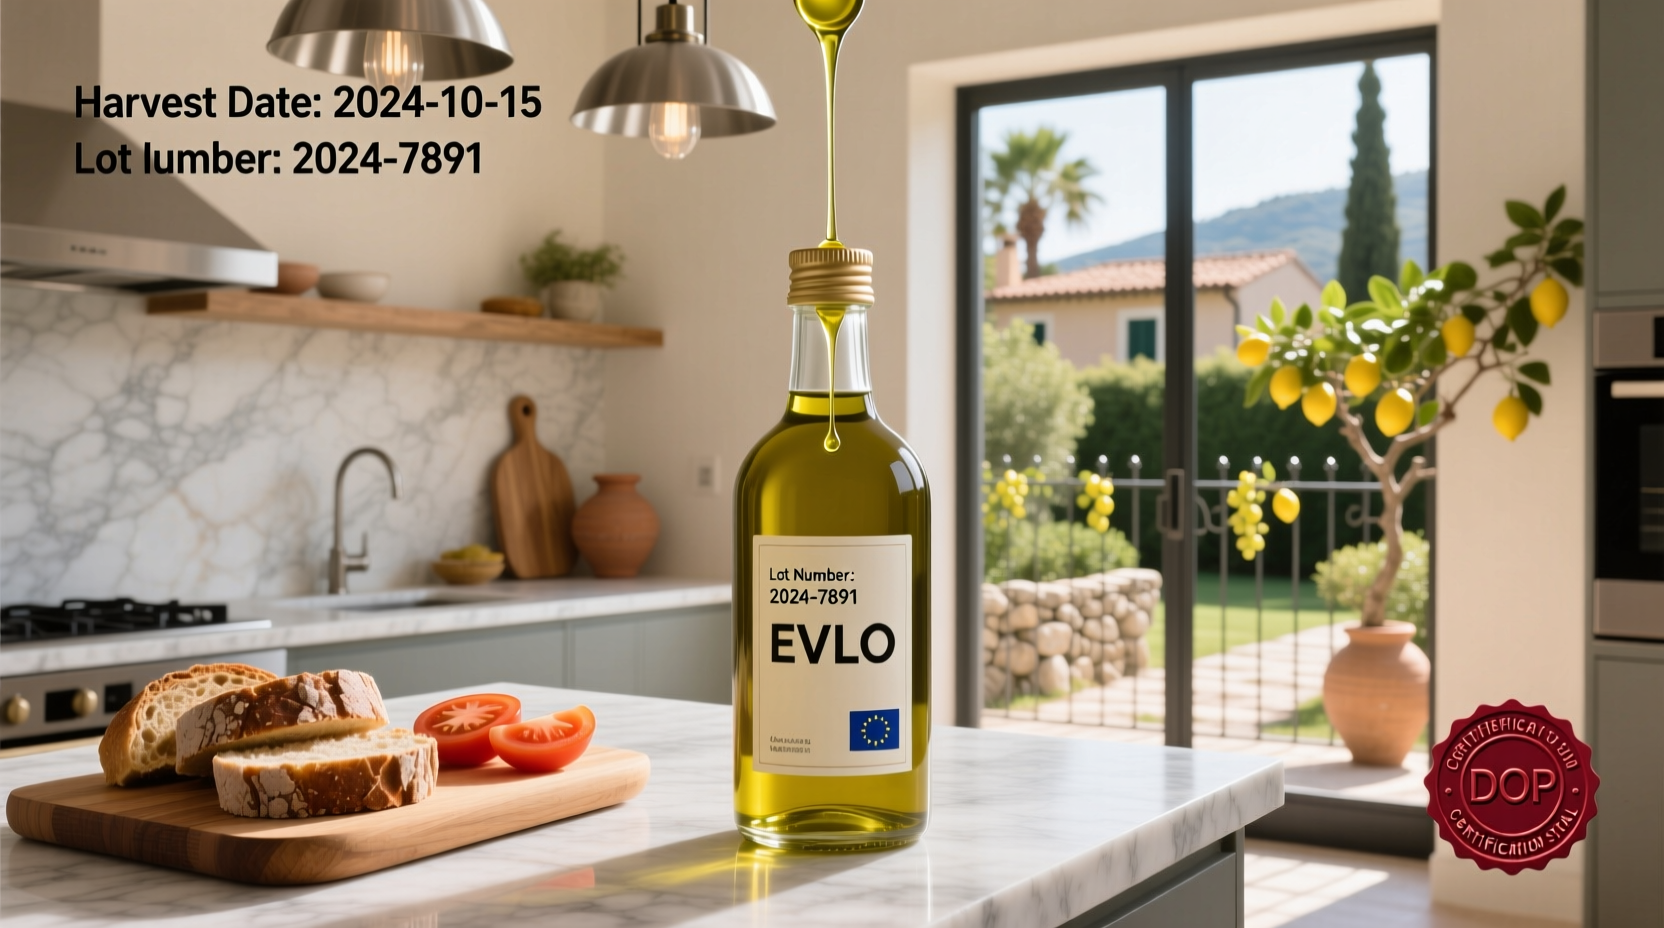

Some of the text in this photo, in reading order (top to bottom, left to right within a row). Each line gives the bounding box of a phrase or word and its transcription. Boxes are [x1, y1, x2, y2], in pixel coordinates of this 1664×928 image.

[769, 567, 855, 582] Lot Number:
[769, 588, 857, 605] 2024-7891
[771, 622, 896, 664] EVLO
